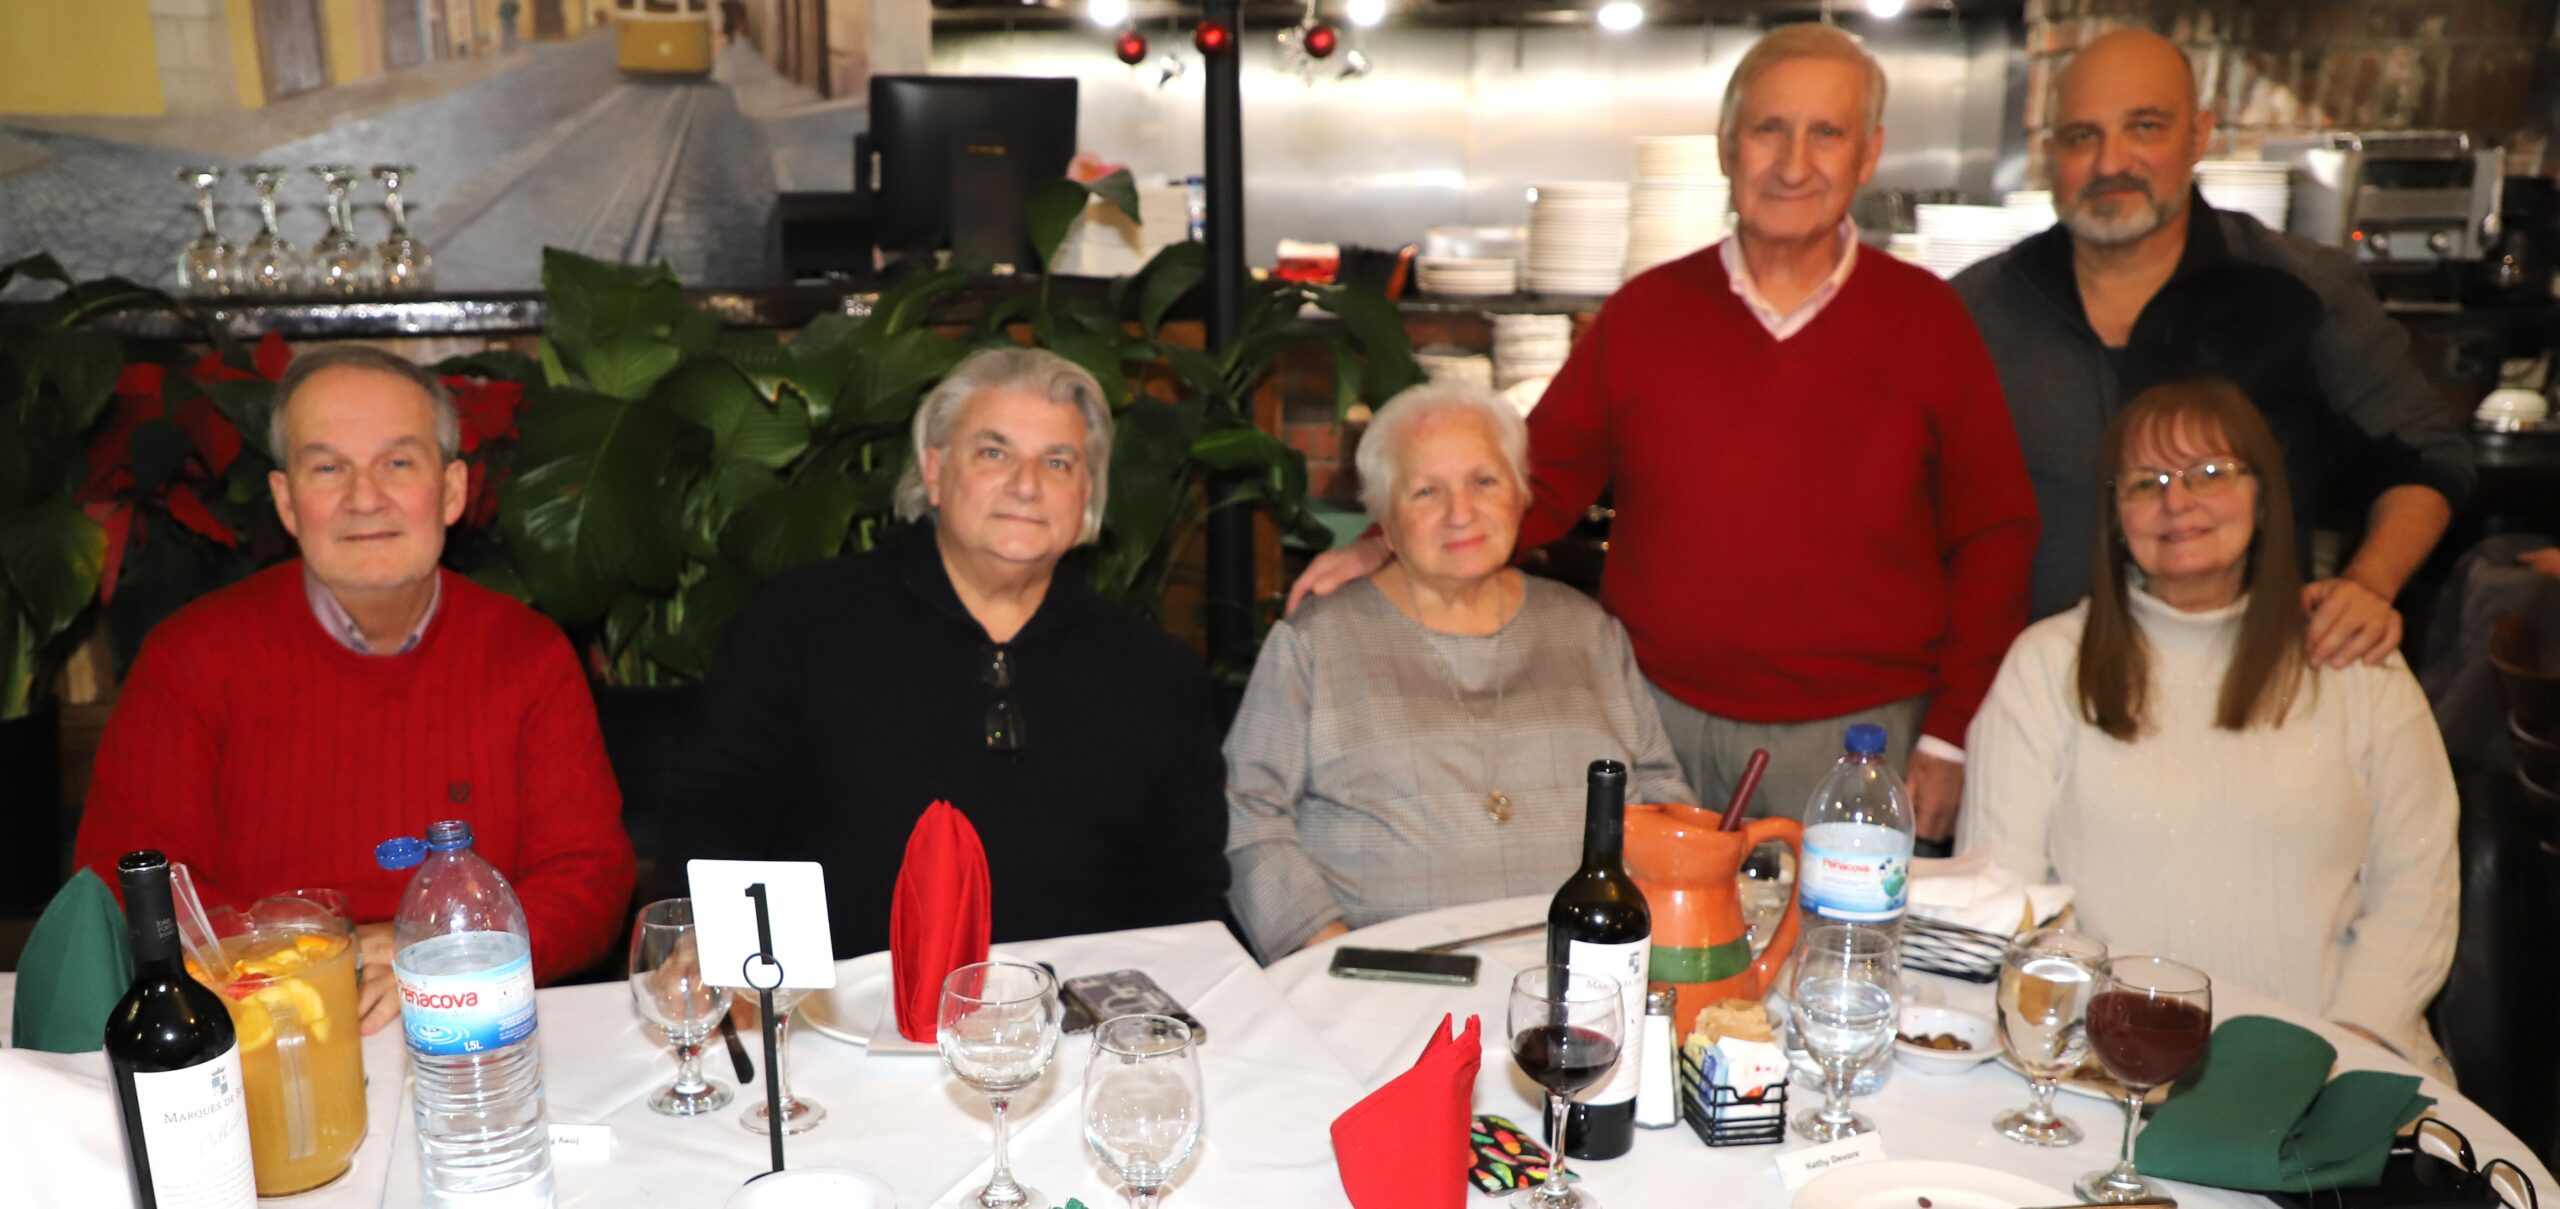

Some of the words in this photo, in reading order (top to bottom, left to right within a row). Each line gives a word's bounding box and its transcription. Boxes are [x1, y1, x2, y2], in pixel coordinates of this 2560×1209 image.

[745, 883, 774, 965] 1
[463, 1040, 483, 1052] 1,5L
[164, 1103, 222, 1124] MARQUES
[1805, 1158, 1830, 1170] Kathy
